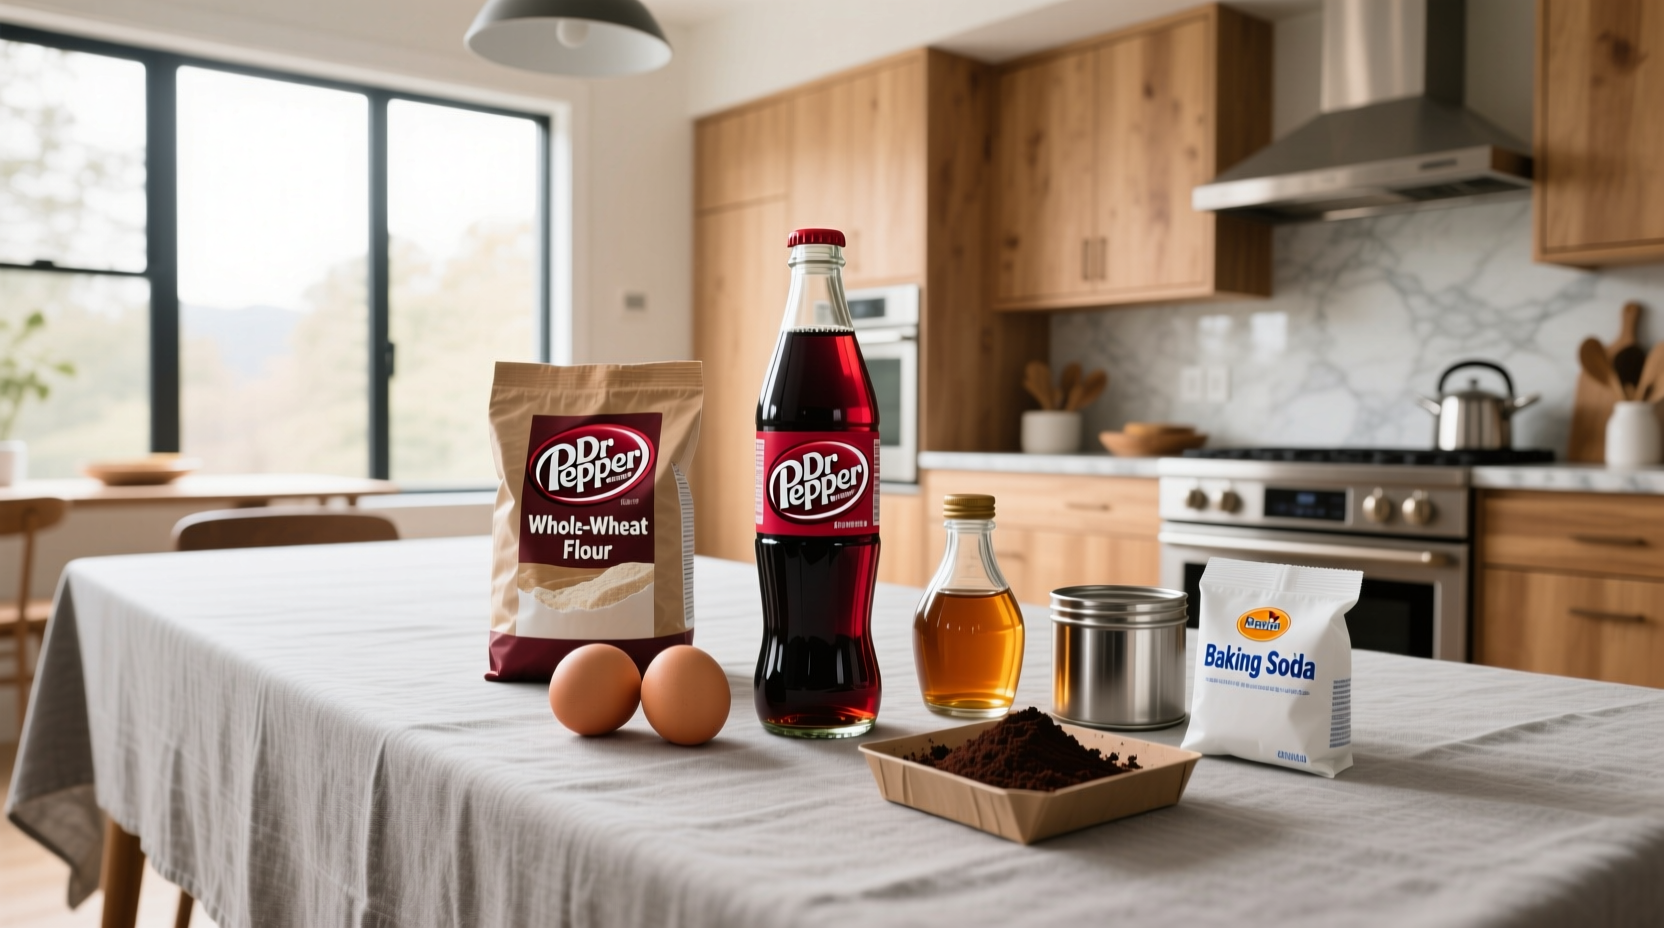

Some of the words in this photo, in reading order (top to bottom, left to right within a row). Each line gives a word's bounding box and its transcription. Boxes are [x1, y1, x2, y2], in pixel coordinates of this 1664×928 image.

[577, 436, 614, 464] Dr
[541, 443, 641, 493] Pepper
[803, 452, 838, 481] Dr
[775, 460, 862, 511] Pepper
[528, 514, 649, 535] Whole-Wheat
[563, 539, 613, 560] Flour
[1204, 643, 1262, 679] Baking
[1265, 650, 1316, 681] Soda
